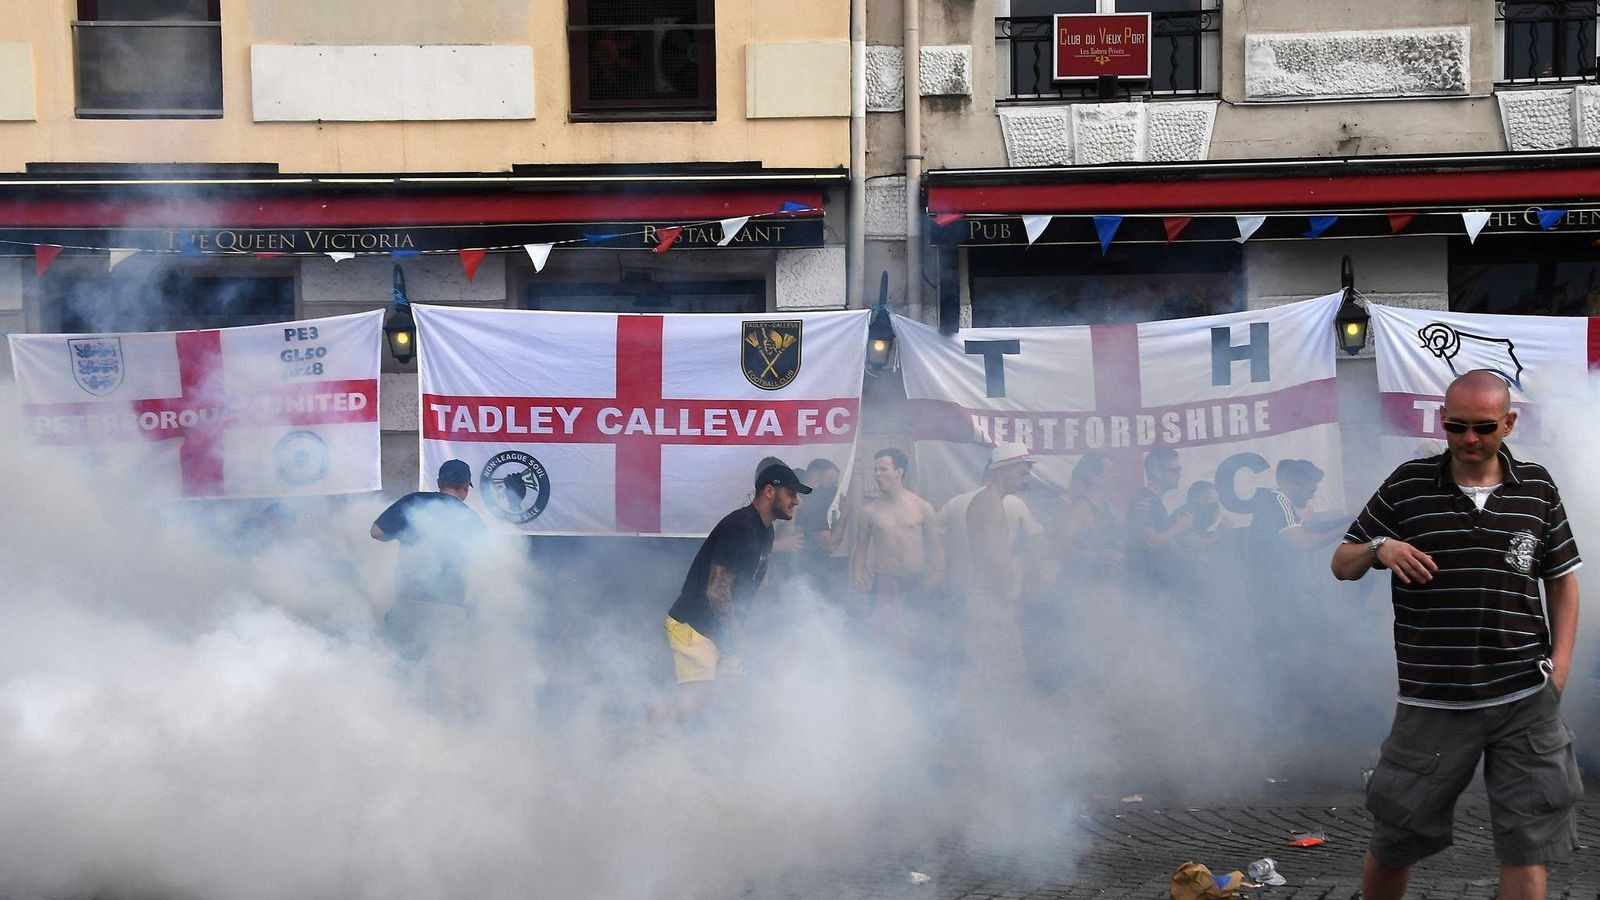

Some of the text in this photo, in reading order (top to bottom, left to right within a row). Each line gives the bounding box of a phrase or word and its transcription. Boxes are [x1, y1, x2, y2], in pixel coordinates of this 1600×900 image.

[1060, 28, 1081, 45] CLUB
[1099, 27, 1122, 45] VIEUX
[1124, 27, 1145, 44] PORT
[969, 220, 1011, 240] PUB
[215, 230, 296, 253] QUEEN
[304, 230, 415, 249] VICTORIA
[284, 327, 319, 341] PE3
[280, 346, 327, 363] GL50
[964, 322, 1271, 399] T H
[430, 403, 851, 437] TADLEY CALLEVA F.C
[971, 400, 1270, 450] HERTFORDSHIRE
[528, 459, 545, 479] SOUL
